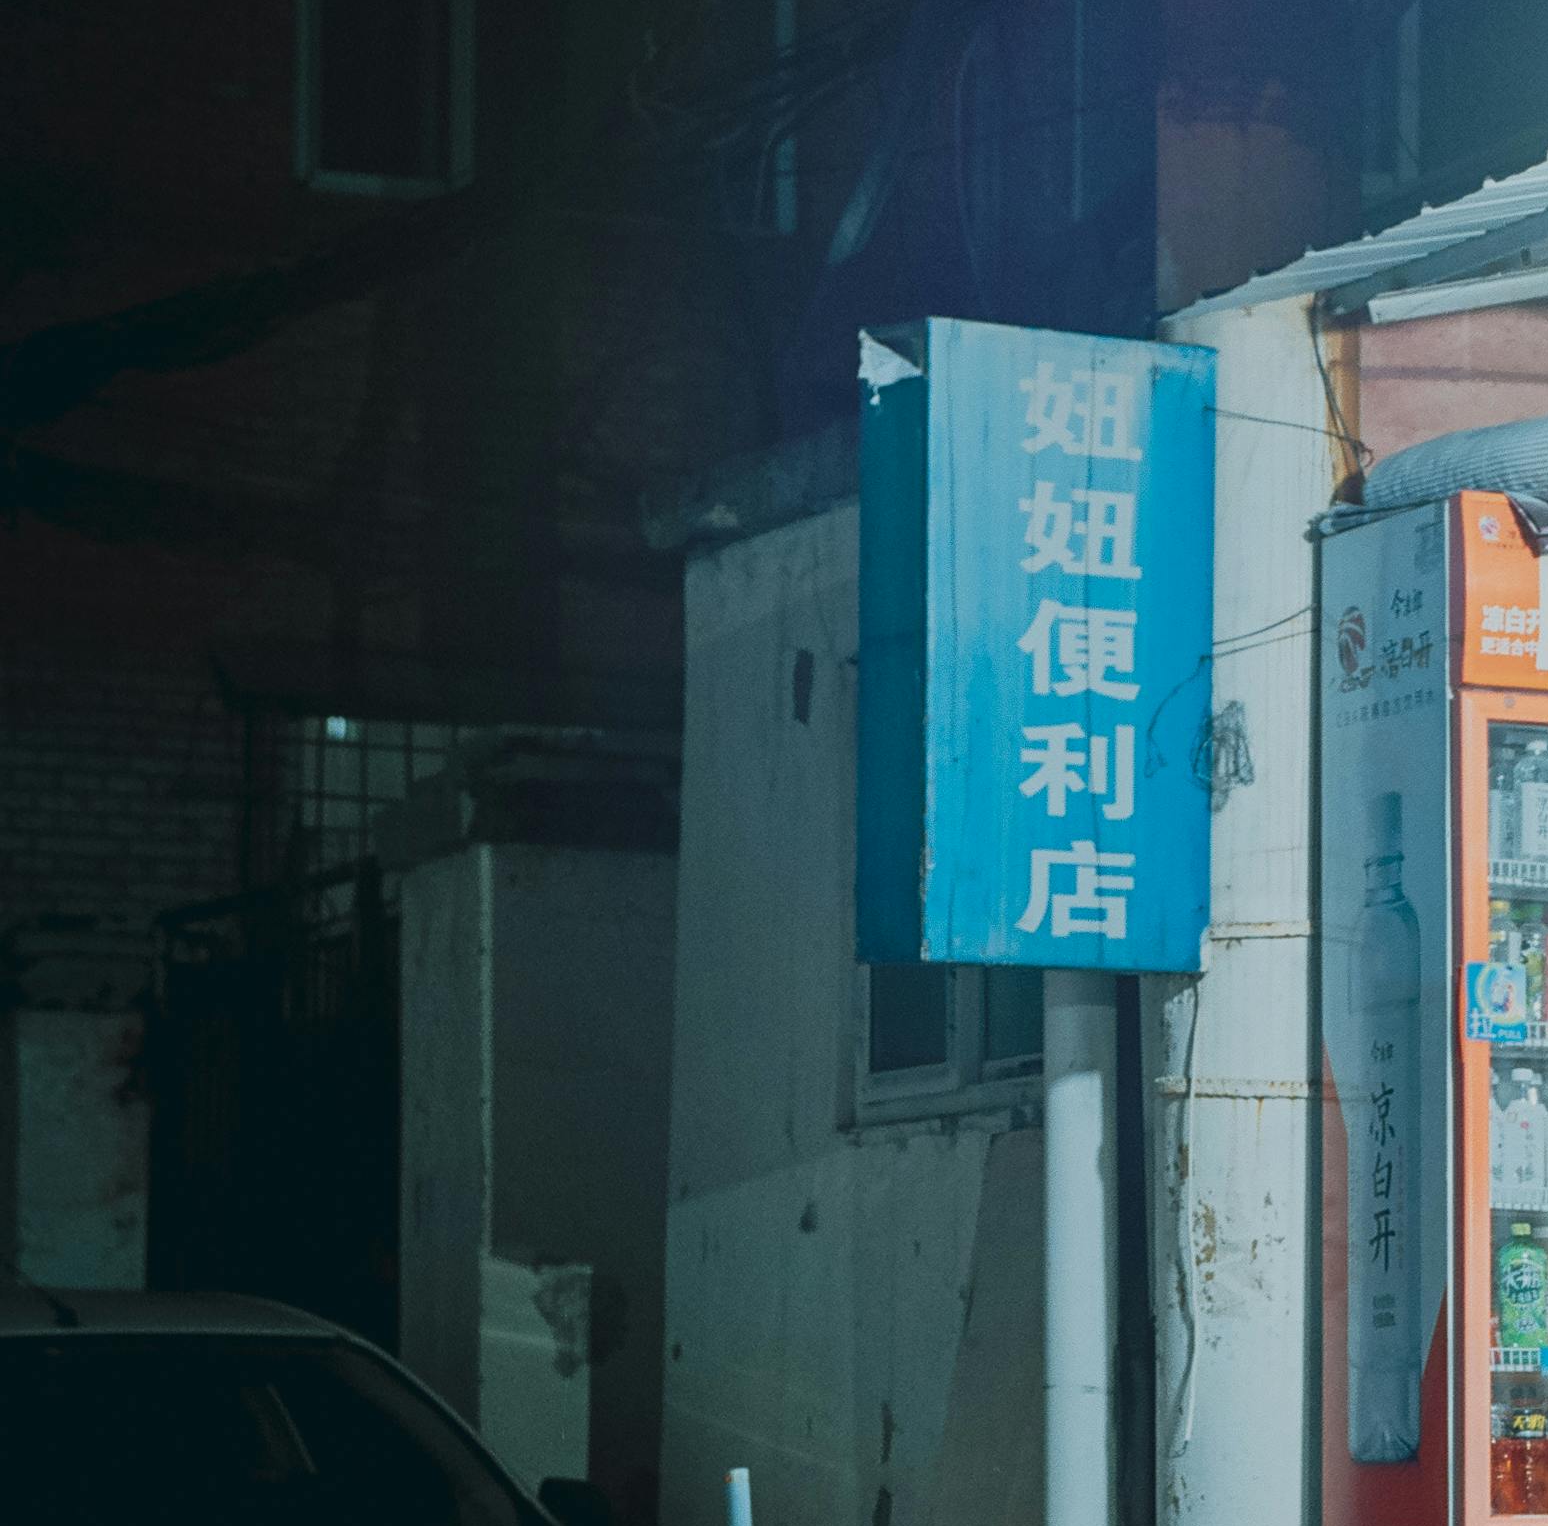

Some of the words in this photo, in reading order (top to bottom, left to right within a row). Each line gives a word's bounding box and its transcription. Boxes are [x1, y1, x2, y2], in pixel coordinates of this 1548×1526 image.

[1018, 359, 1143, 940] 妞妞便利店
